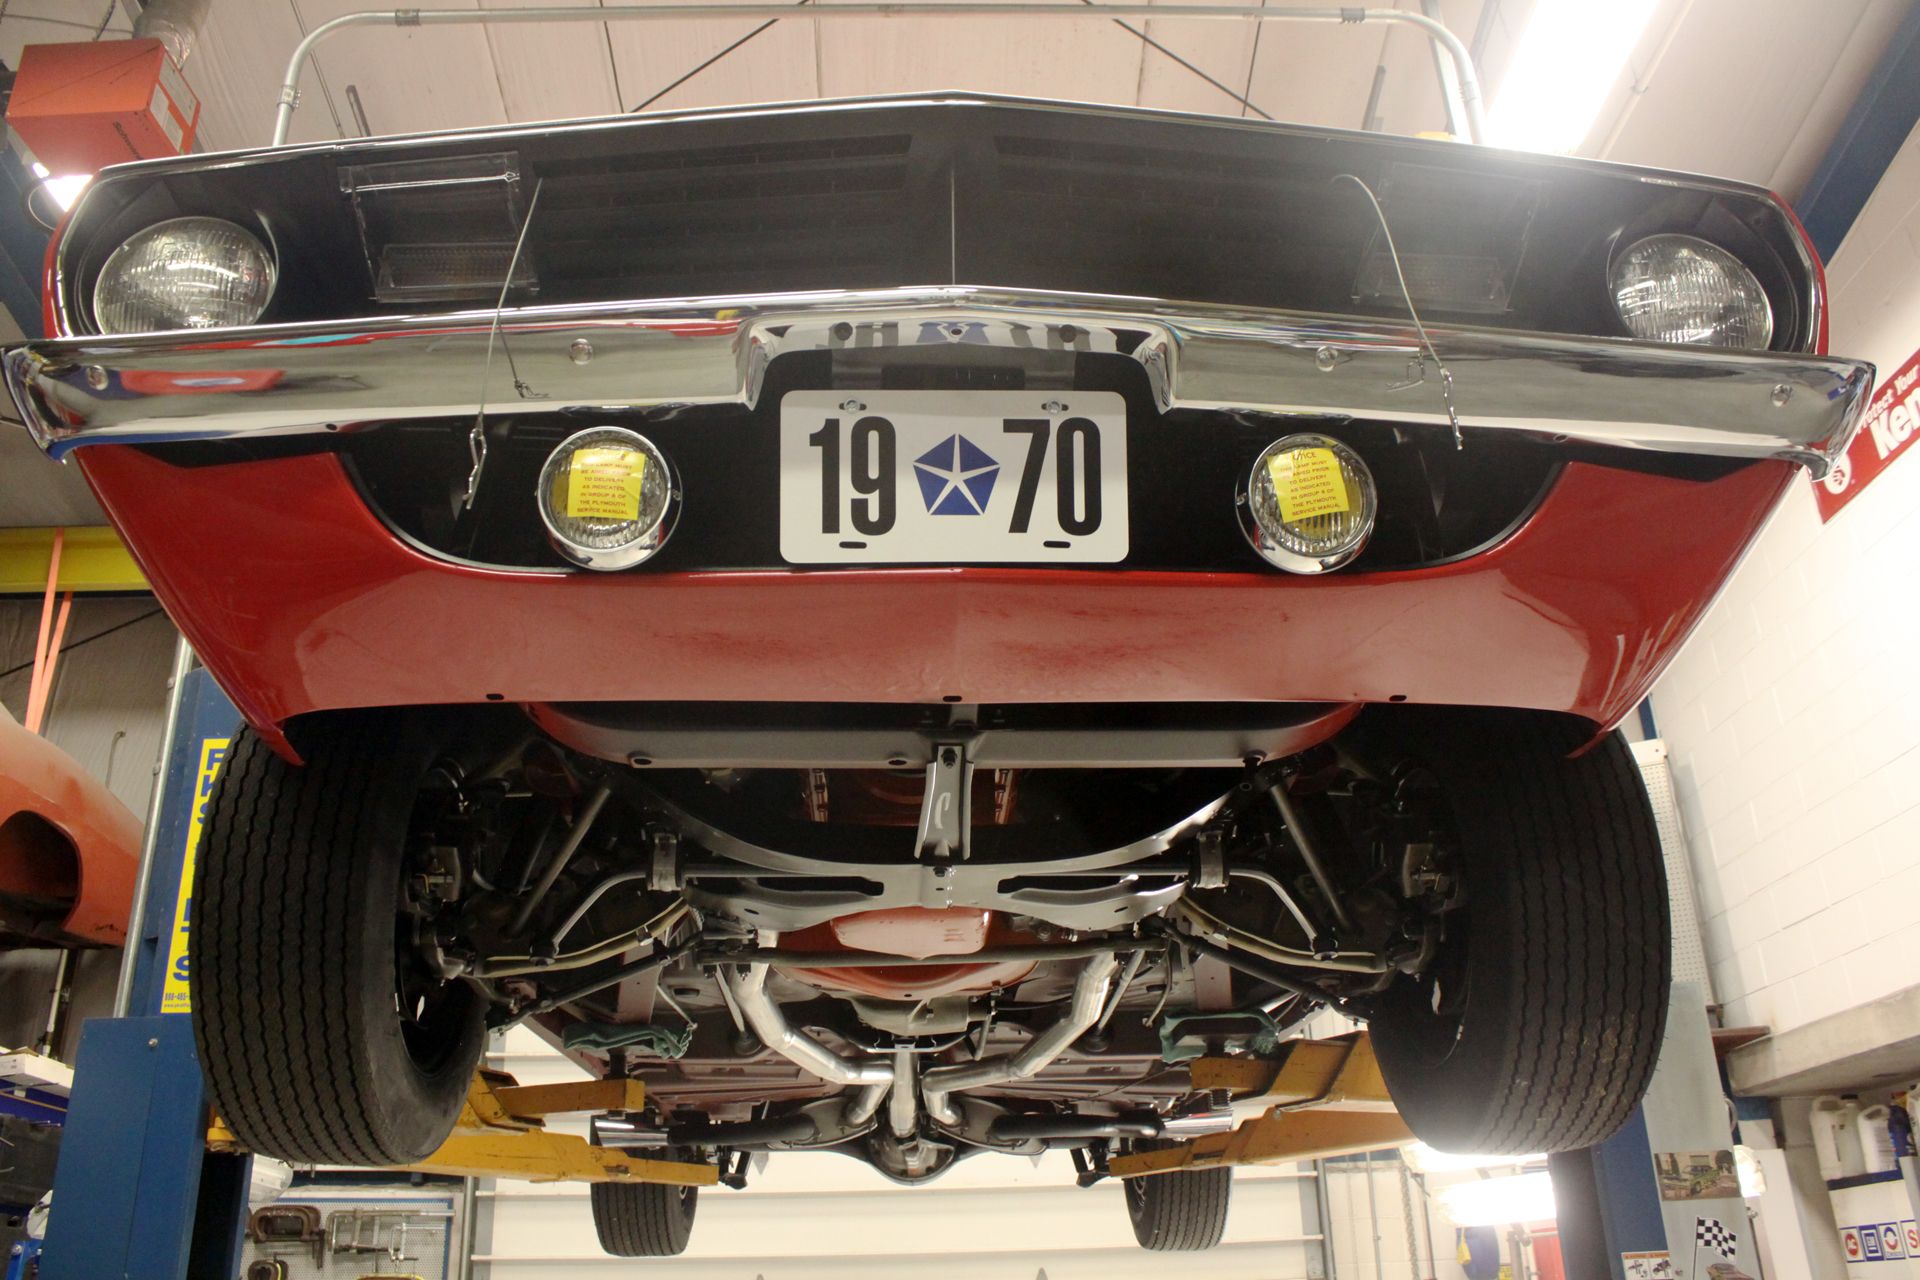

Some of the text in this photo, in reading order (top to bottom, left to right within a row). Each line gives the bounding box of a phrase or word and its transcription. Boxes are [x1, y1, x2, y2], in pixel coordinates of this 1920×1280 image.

[1894, 365, 1919, 395] Your
[809, 416, 1102, 536] 19 70
